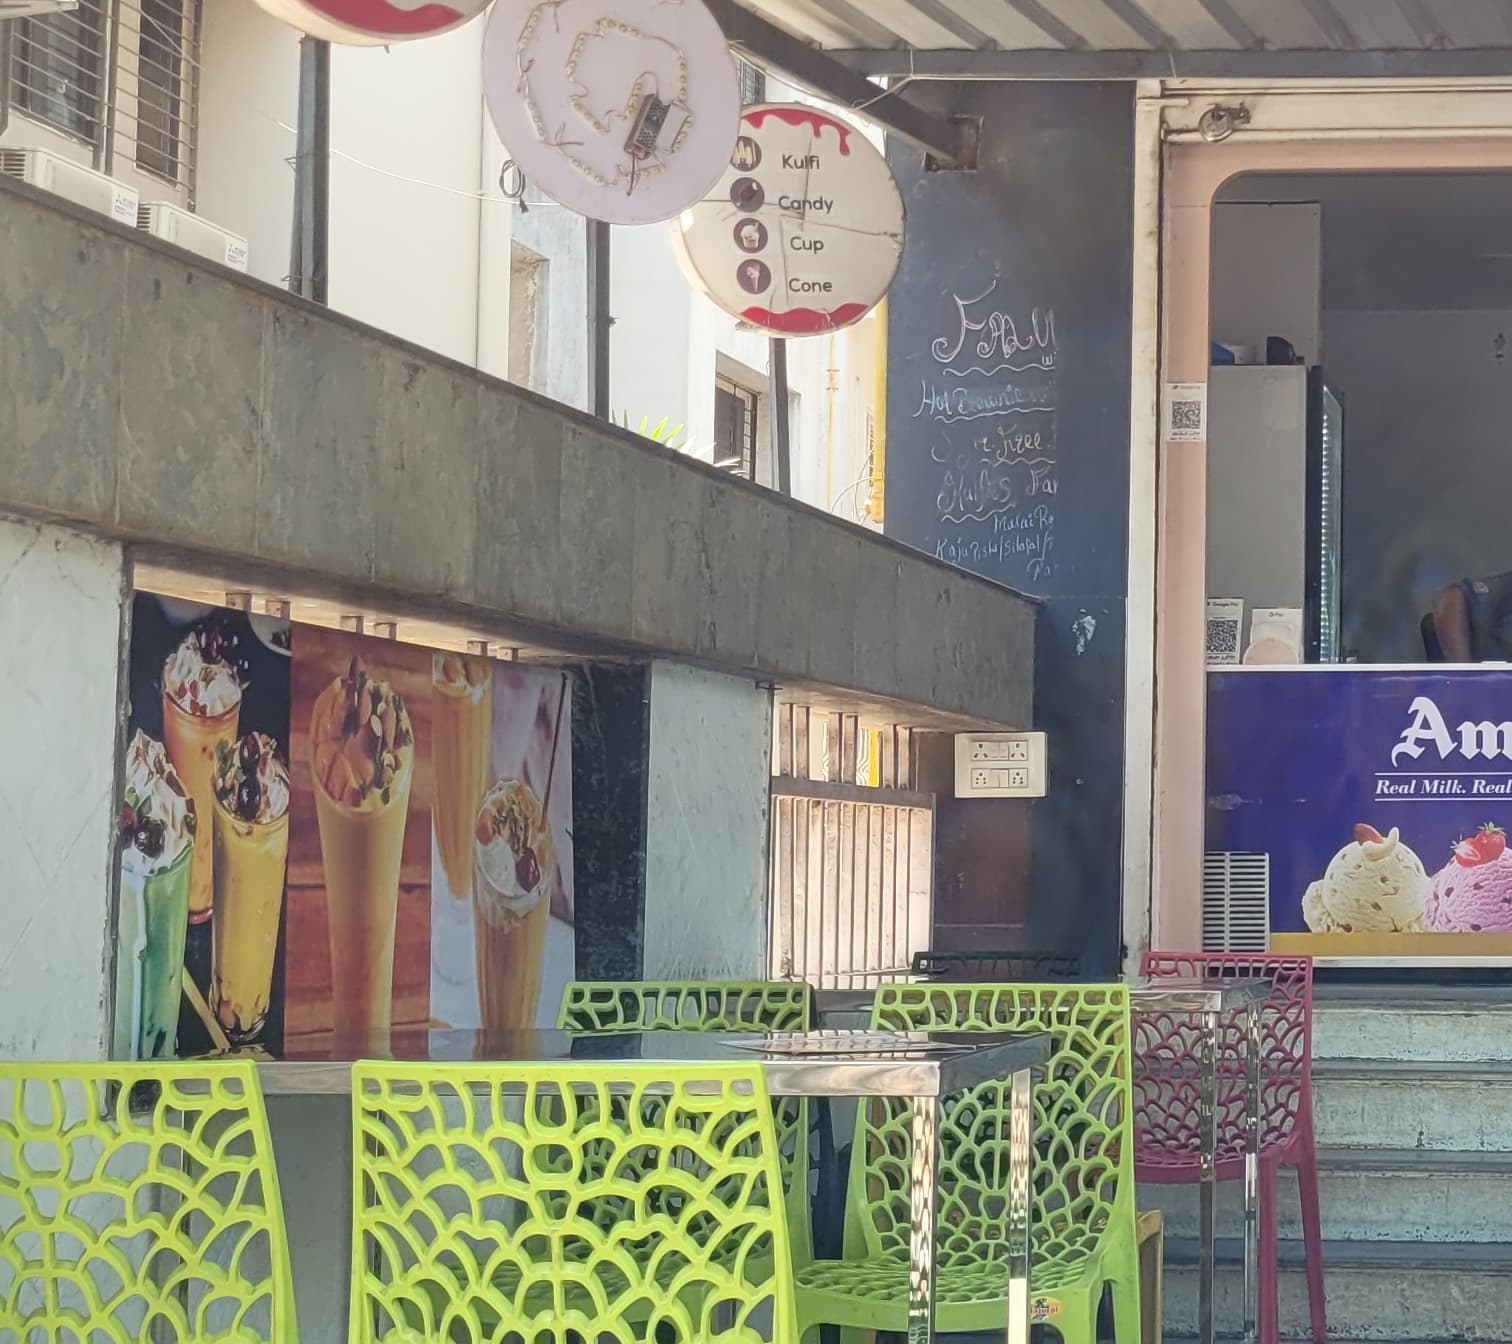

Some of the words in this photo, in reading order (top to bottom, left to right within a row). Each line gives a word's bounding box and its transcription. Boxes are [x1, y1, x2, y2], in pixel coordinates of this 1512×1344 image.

[782, 154, 820, 170] Kulfi
[777, 196, 834, 213] Candy
[789, 236, 824, 254] Cup
[788, 278, 833, 293] Cone
[1376, 779, 1416, 795] Real
[1421, 779, 1466, 795] Milk.
[1471, 779, 1512, 794] Real
